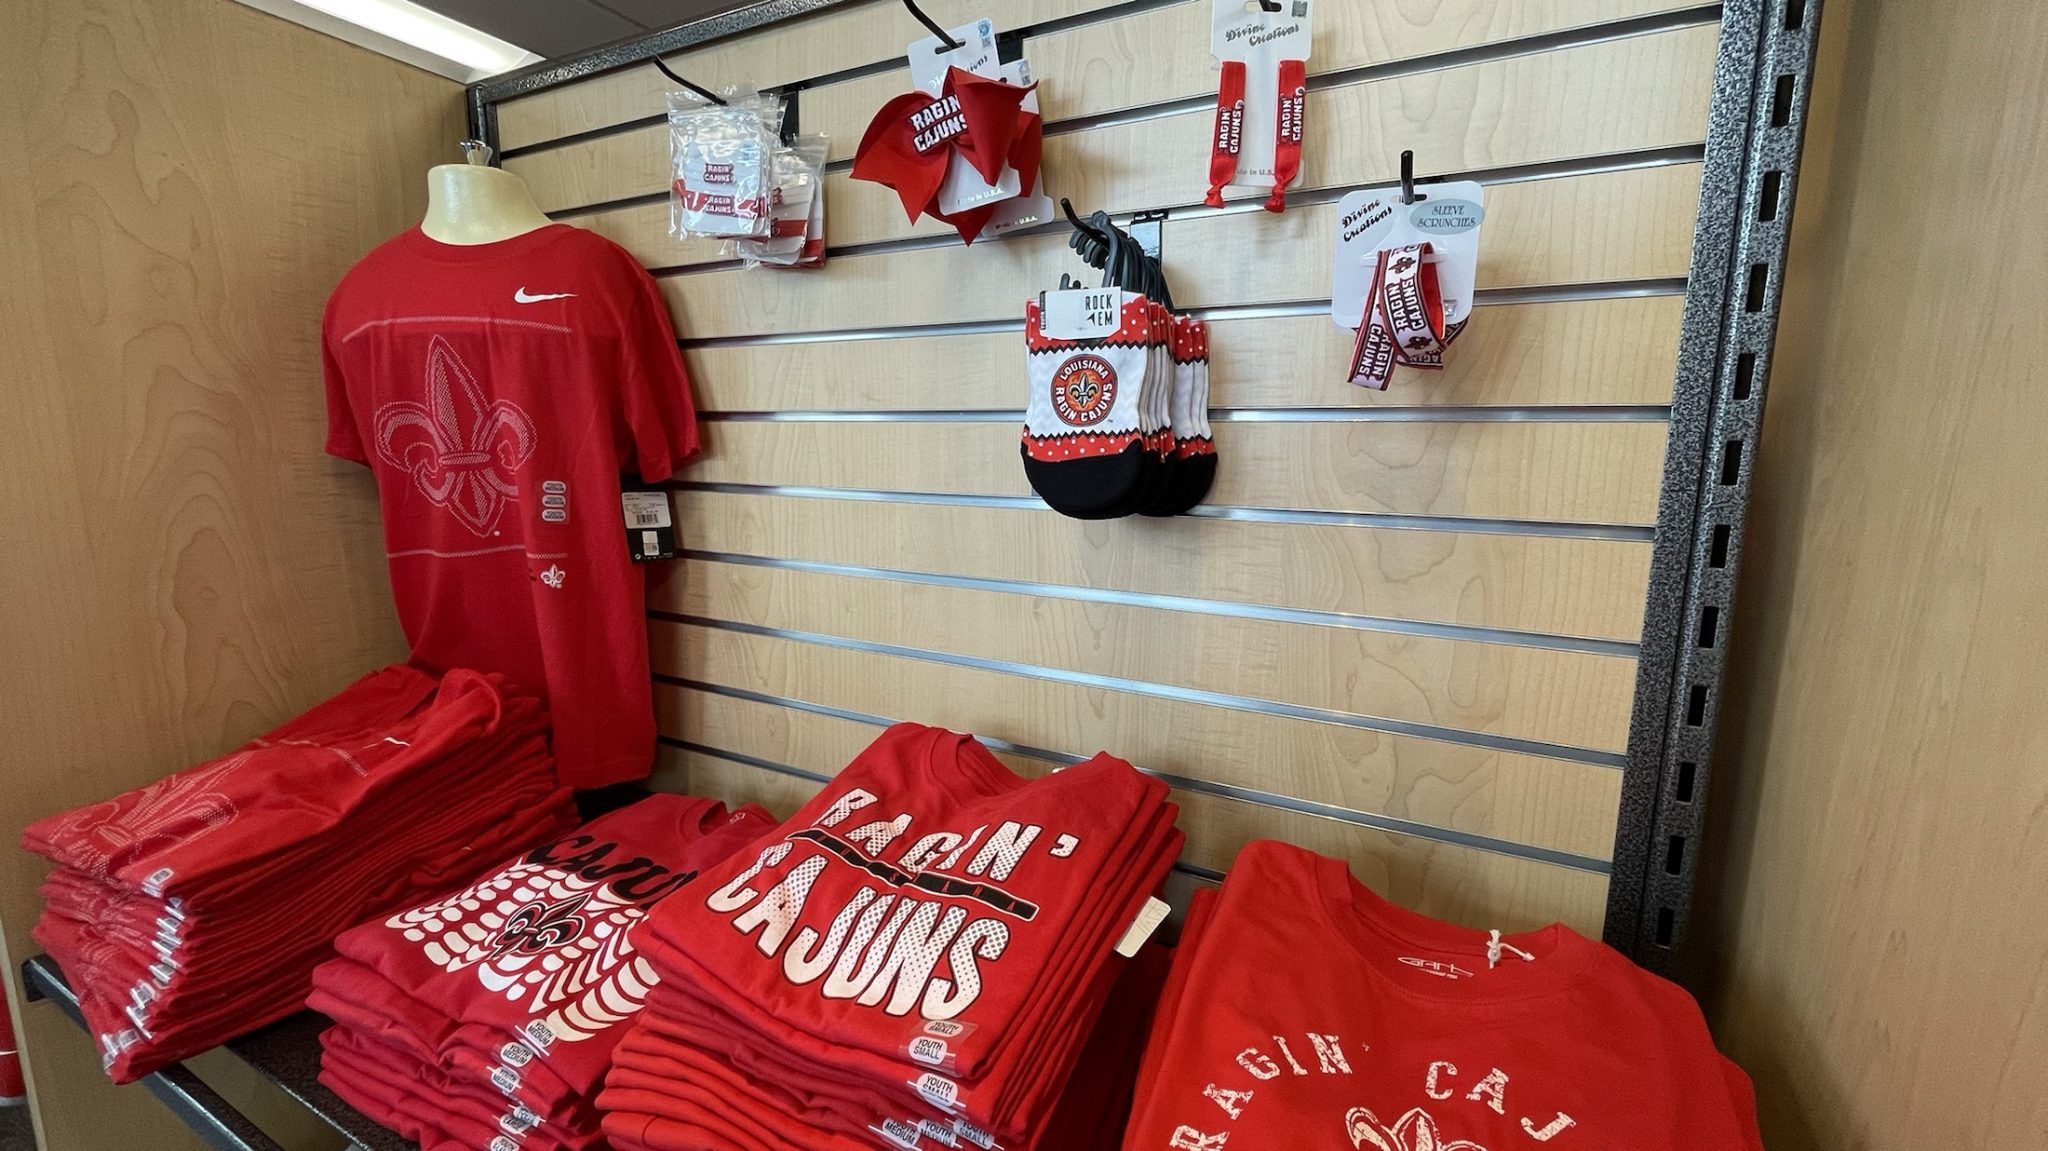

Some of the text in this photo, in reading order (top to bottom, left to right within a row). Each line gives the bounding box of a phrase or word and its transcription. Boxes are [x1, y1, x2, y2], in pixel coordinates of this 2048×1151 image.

[1292, 97, 1303, 141] CAJUNS
[1229, 110, 1241, 153] CAJUNS
[1342, 199, 1380, 228] Divine
[1432, 205, 1465, 216] SLEEVE
[1344, 206, 1392, 242] Creations
[1085, 294, 1112, 310] ROCK
[1401, 278, 1424, 331] CAJUNS
[1360, 324, 1382, 375] CAJUNS
[1060, 359, 1109, 380] LOUISIANA
[1056, 383, 1113, 421] RAGIN CAJUNS
[705, 842, 1010, 1020] CAJUNS
[528, 1025, 550, 1045] MEDIUM
[535, 1022, 554, 1039] YOUTH
[928, 1025, 954, 1035] SMALL
[934, 1021, 960, 1031] YOUTH
[509, 1044, 531, 1058] YOUTH
[914, 1046, 940, 1060] SMALL
[918, 1039, 944, 1051] YOUTH
[926, 1075, 953, 1093] YOUTH
[884, 1121, 916, 1145] MEDIUM
[925, 1120, 953, 1138] YOUTH
[959, 1128, 988, 1147] SMALL
